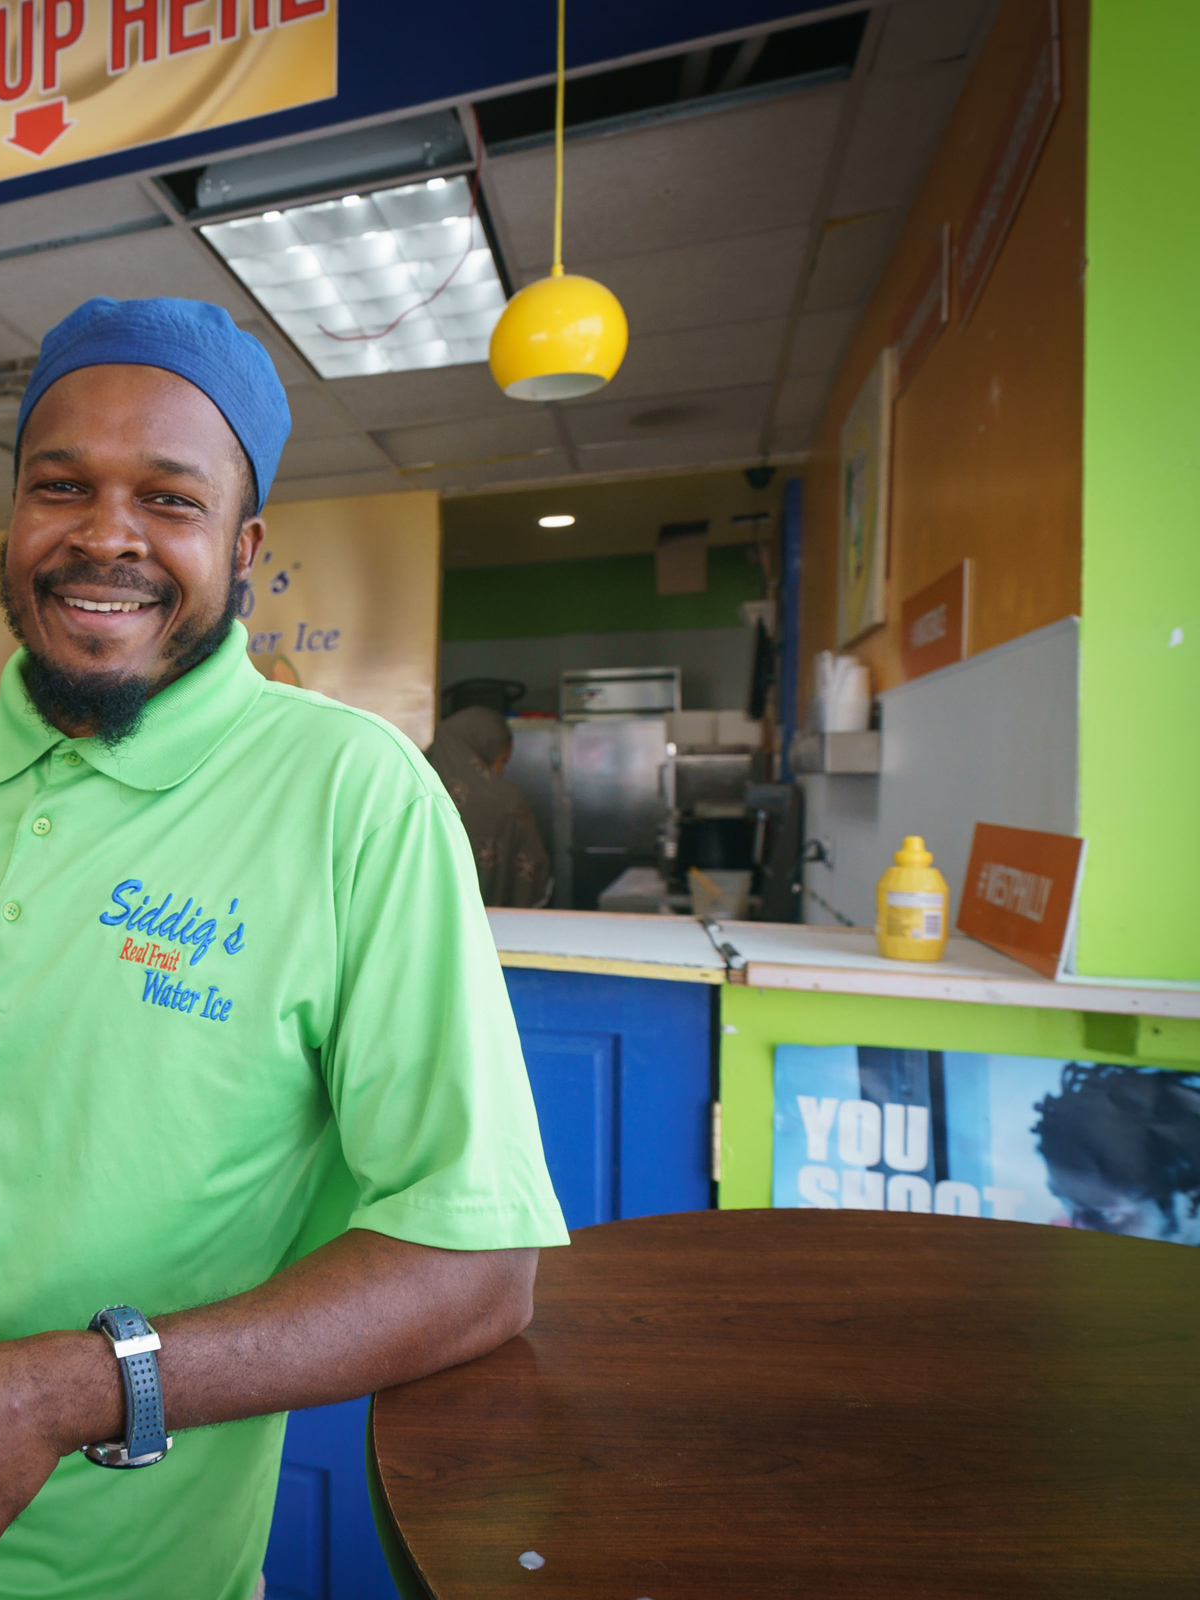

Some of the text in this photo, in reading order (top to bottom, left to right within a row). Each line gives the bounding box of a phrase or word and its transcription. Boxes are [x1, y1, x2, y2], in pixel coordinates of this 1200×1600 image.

[293, 621, 341, 653] Ice
[119, 936, 181, 972] Real Fruit
[142, 969, 233, 1022] Water Ice
[796, 1094, 930, 1172] YOU
